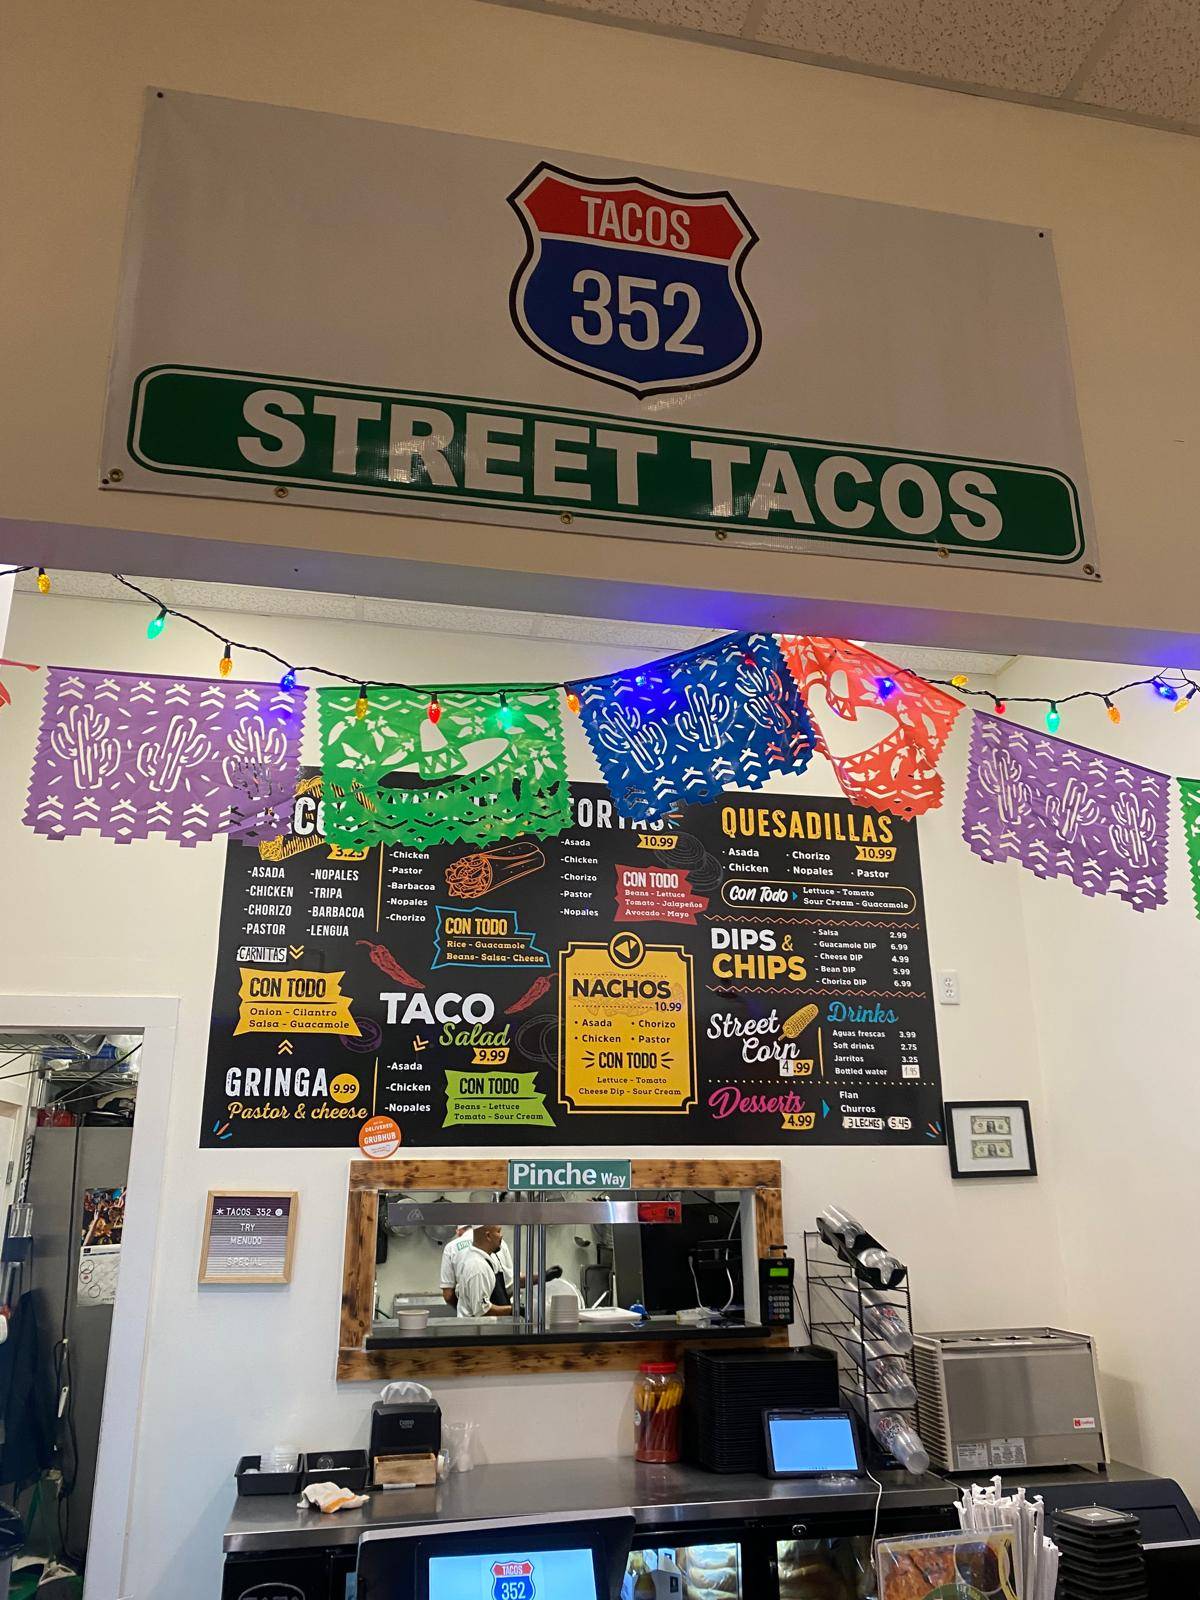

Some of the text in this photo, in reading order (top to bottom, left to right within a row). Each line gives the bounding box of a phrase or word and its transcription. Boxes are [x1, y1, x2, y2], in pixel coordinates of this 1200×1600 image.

[580, 195, 691, 250] TACOS
[570, 269, 704, 355] 352
[236, 386, 1004, 544] STREET TACOS
[721, 806, 893, 844] QUESADILLAS
[643, 836, 674, 848] 10.99
[728, 847, 760, 857] Asada
[792, 851, 831, 861] Chorizo
[862, 848, 892, 859] 10.99
[728, 863, 769, 873] Chicken
[793, 866, 834, 877] Nopales
[857, 869, 890, 879] Pastor
[623, 871, 679, 889] CON TODO
[625, 889, 686, 898] Beans Lettuce
[729, 885, 788, 903] Con Todo
[803, 887, 874, 897] Lettuce Tomato
[625, 899, 703, 909] Tomato Jalapeños
[803, 897, 909, 909] Sour Cream Guacamole
[625, 908, 689, 918] Avocado Mayo
[445, 917, 508, 936] CON TODO
[710, 927, 794, 951] DIPS &
[818, 929, 907, 939] Salsa 2.99
[446, 940, 526, 950] Rice Guacamole
[819, 941, 862, 950] Guacamole
[890, 943, 908, 951] 6.99
[238, 946, 286, 962] CARNITAS
[513, 954, 544, 963] Cheese
[819, 953, 848, 961] Cheese
[891, 955, 909, 963] 4.99
[712, 952, 807, 981] CHIPS
[892, 968, 910, 976] 5.99
[249, 977, 327, 998] CON TODO
[821, 977, 912, 988] Chorizo DIP 6.99
[572, 978, 672, 999] NACHOS
[379, 992, 495, 1025] TACO
[655, 1001, 682, 1012] 10.99
[826, 1001, 899, 1023] Drinks
[250, 1008, 337, 1017] Onion Cilantro
[248, 1019, 350, 1029] Salsa Guacamole
[582, 1019, 676, 1028] Asada Chorizo
[706, 1008, 780, 1039] Street
[438, 1021, 511, 1046] Salad
[582, 1034, 671, 1043] Chicken Pastor
[832, 1029, 917, 1039] Aguas frescas 3.99
[741, 1036, 800, 1063] Corn
[850, 1042, 875, 1050] drinks
[900, 1043, 918, 1051] 2.75
[478, 1049, 506, 1062] 9.99
[598, 1051, 658, 1069] CON TODO
[835, 1067, 863, 1075] Bottled
[225, 1066, 356, 1097] GRINGA 9.99
[597, 1076, 628, 1084] Lettuce
[459, 1077, 520, 1095] CON TODO
[610, 1088, 625, 1096] Dip
[839, 1090, 859, 1099] Flan
[708, 1086, 806, 1119] Desserts
[227, 1101, 368, 1119] Pastor & cheese
[840, 1104, 876, 1113] Churros
[787, 1115, 812, 1127] 4.99
[363, 1132, 397, 1144] GRUBHUB
[513, 1162, 626, 1188] Pinche Way
[226, 1207, 272, 1217] TACOS 352
[240, 1223, 256, 1232] TRY
[230, 1236, 262, 1245] MENUDO
[501, 1565, 523, 1576] TACOS
[501, 1581, 526, 1600] 352
